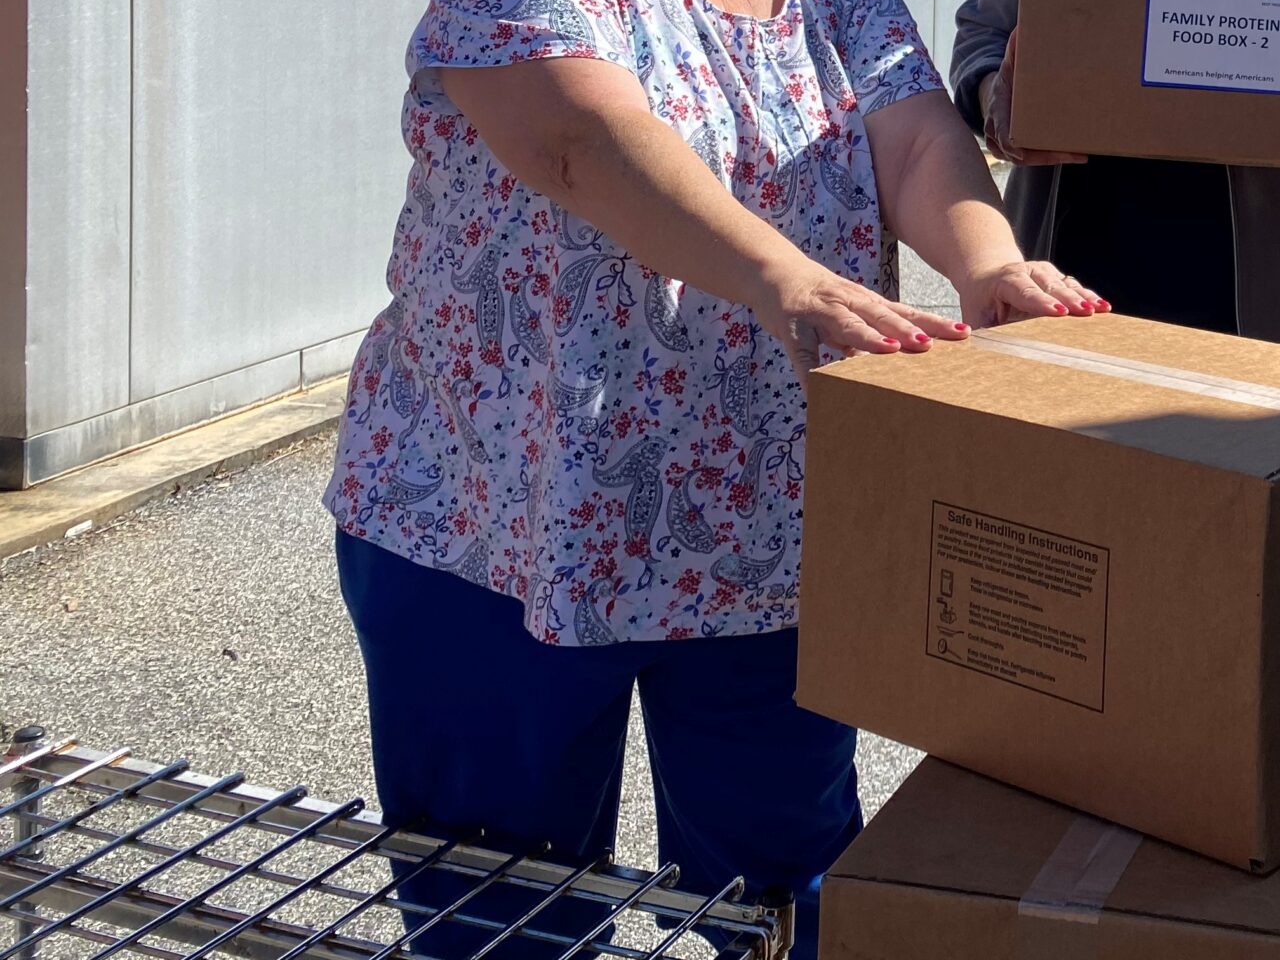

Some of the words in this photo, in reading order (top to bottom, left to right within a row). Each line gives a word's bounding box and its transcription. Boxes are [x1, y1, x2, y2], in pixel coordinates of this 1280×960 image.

[1162, 12, 1215, 27] FAMILY
[1219, 16, 1280, 32] PROTEIN
[1173, 30, 1214, 44] FOOD
[1218, 34, 1247, 47] BOX
[1260, 37, 1269, 49] 2
[1165, 68, 1204, 77] Americans
[1206, 71, 1233, 81] helping
[1235, 73, 1275, 82] Americans
[948, 511, 972, 526] Safe
[975, 517, 1025, 544] Handling
[1029, 533, 1098, 563] Instructions
